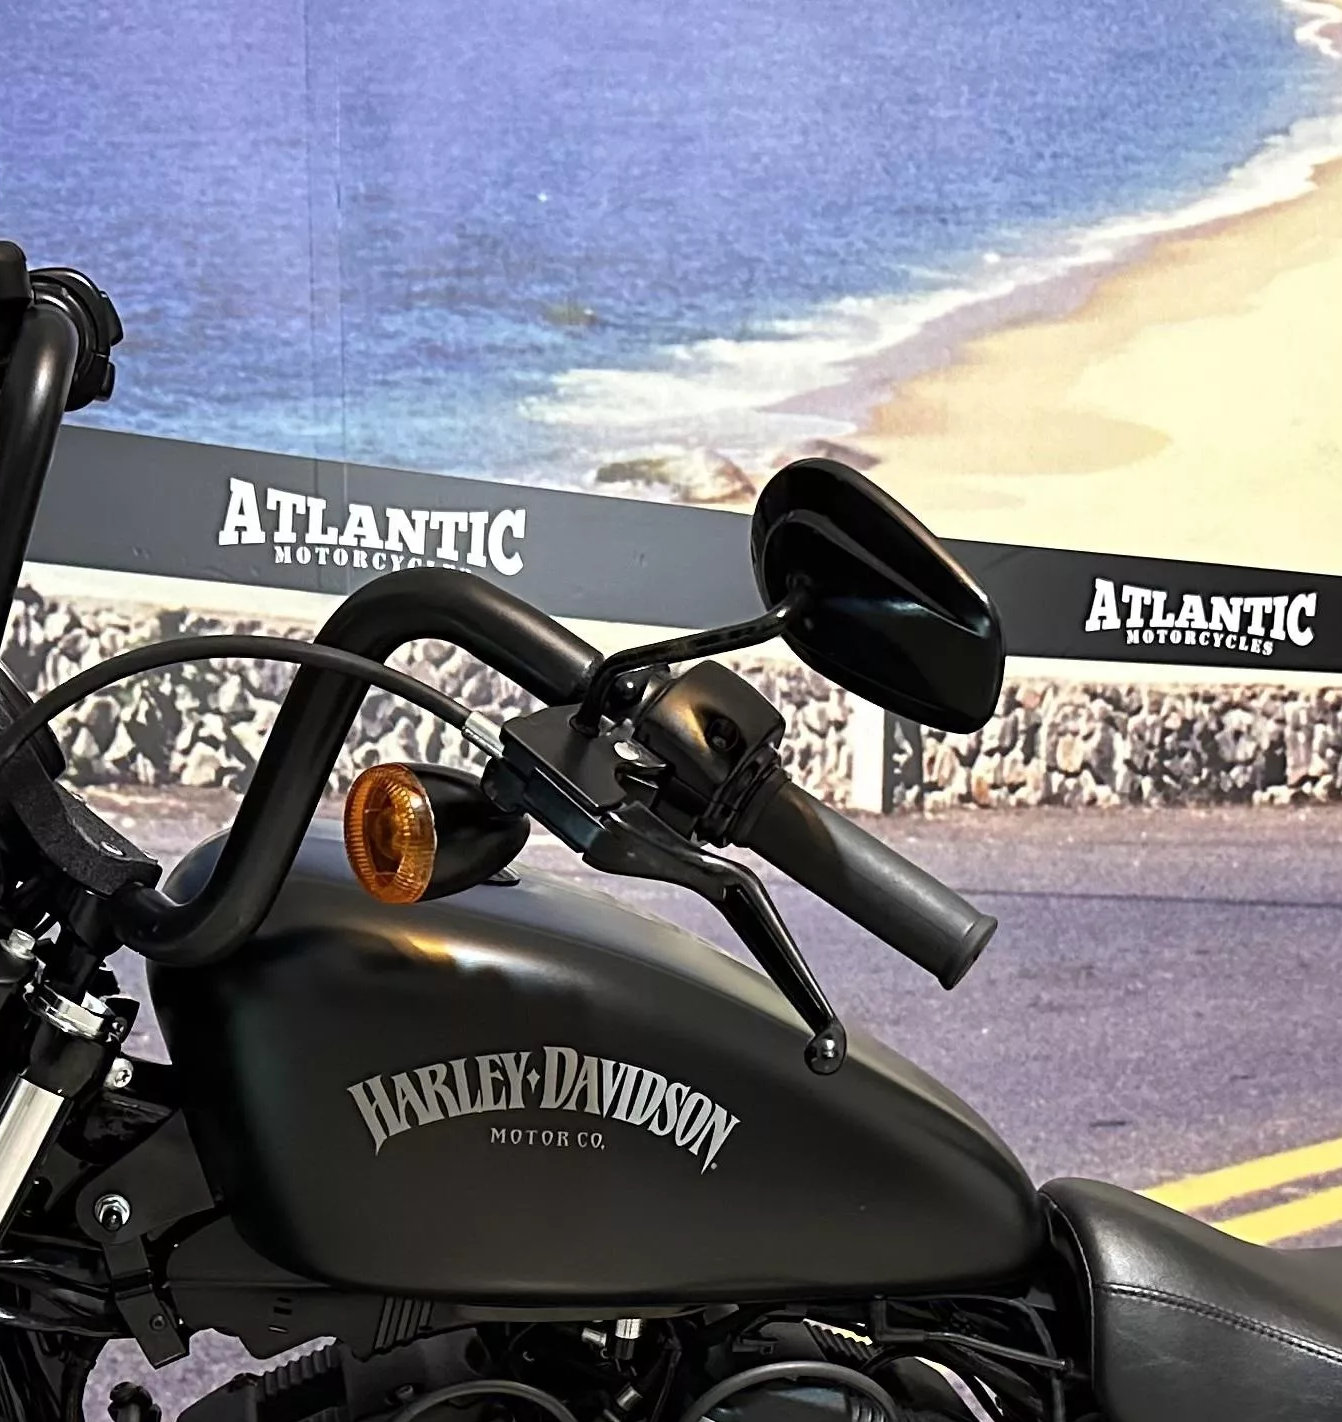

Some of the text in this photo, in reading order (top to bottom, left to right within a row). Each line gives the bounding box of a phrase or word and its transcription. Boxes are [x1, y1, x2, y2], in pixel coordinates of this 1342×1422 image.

[218, 477, 527, 576] ATLANTIC
[1084, 577, 1318, 647] ATLANTIC
[1126, 629, 1274, 656] MOTORCYCLES
[490, 1127, 606, 1151] MOTOR CO.
